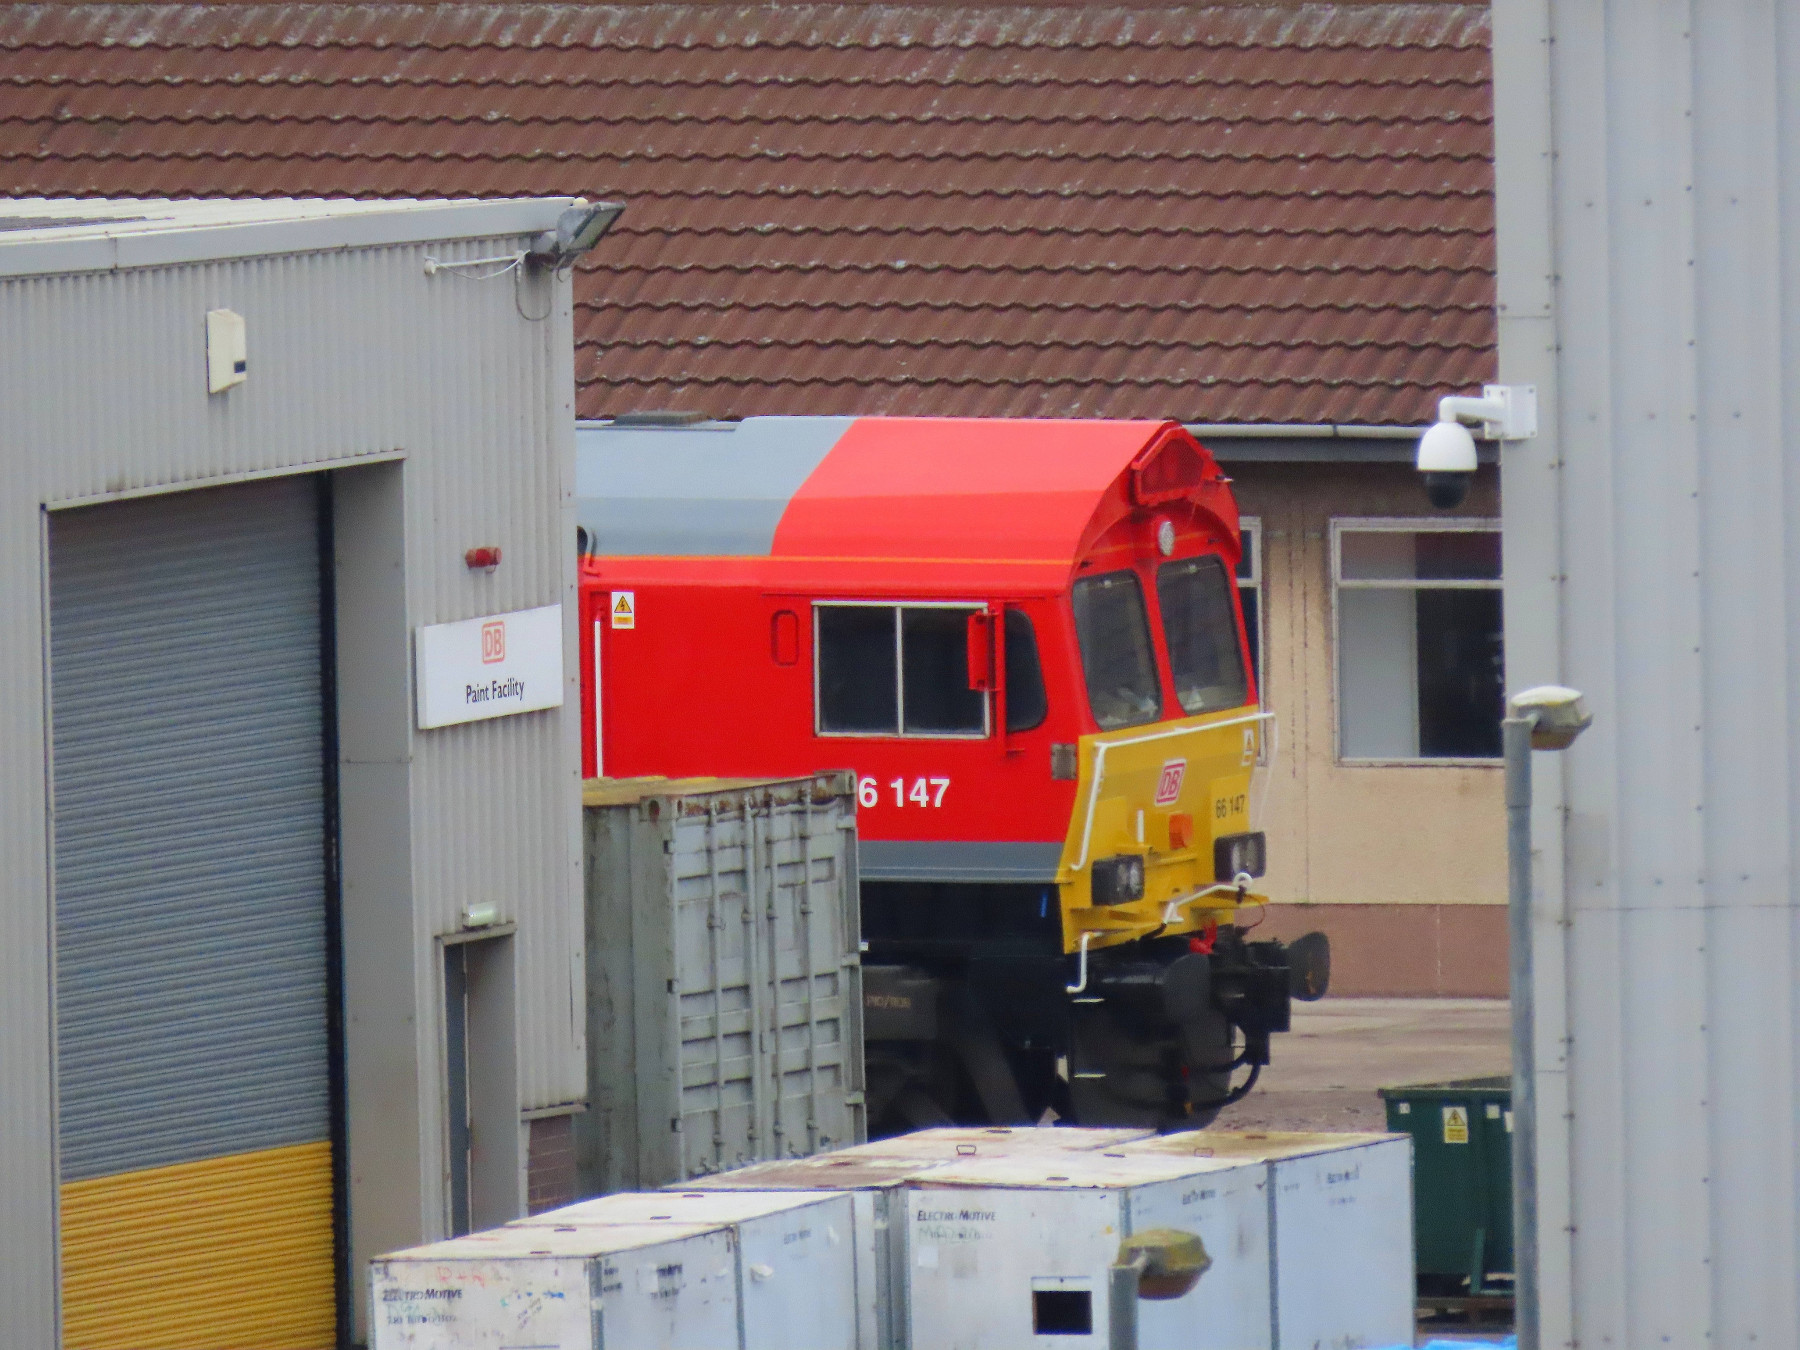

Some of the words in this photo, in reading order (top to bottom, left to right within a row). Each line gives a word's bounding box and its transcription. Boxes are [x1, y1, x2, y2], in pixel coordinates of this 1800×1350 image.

[484, 628, 503, 657] DB
[466, 685, 490, 704] Paint
[492, 677, 525, 701] Facility
[890, 778, 951, 808] 147
[1159, 769, 1182, 798] DB
[1215, 797, 1227, 819] 66
[1229, 794, 1246, 816] 147
